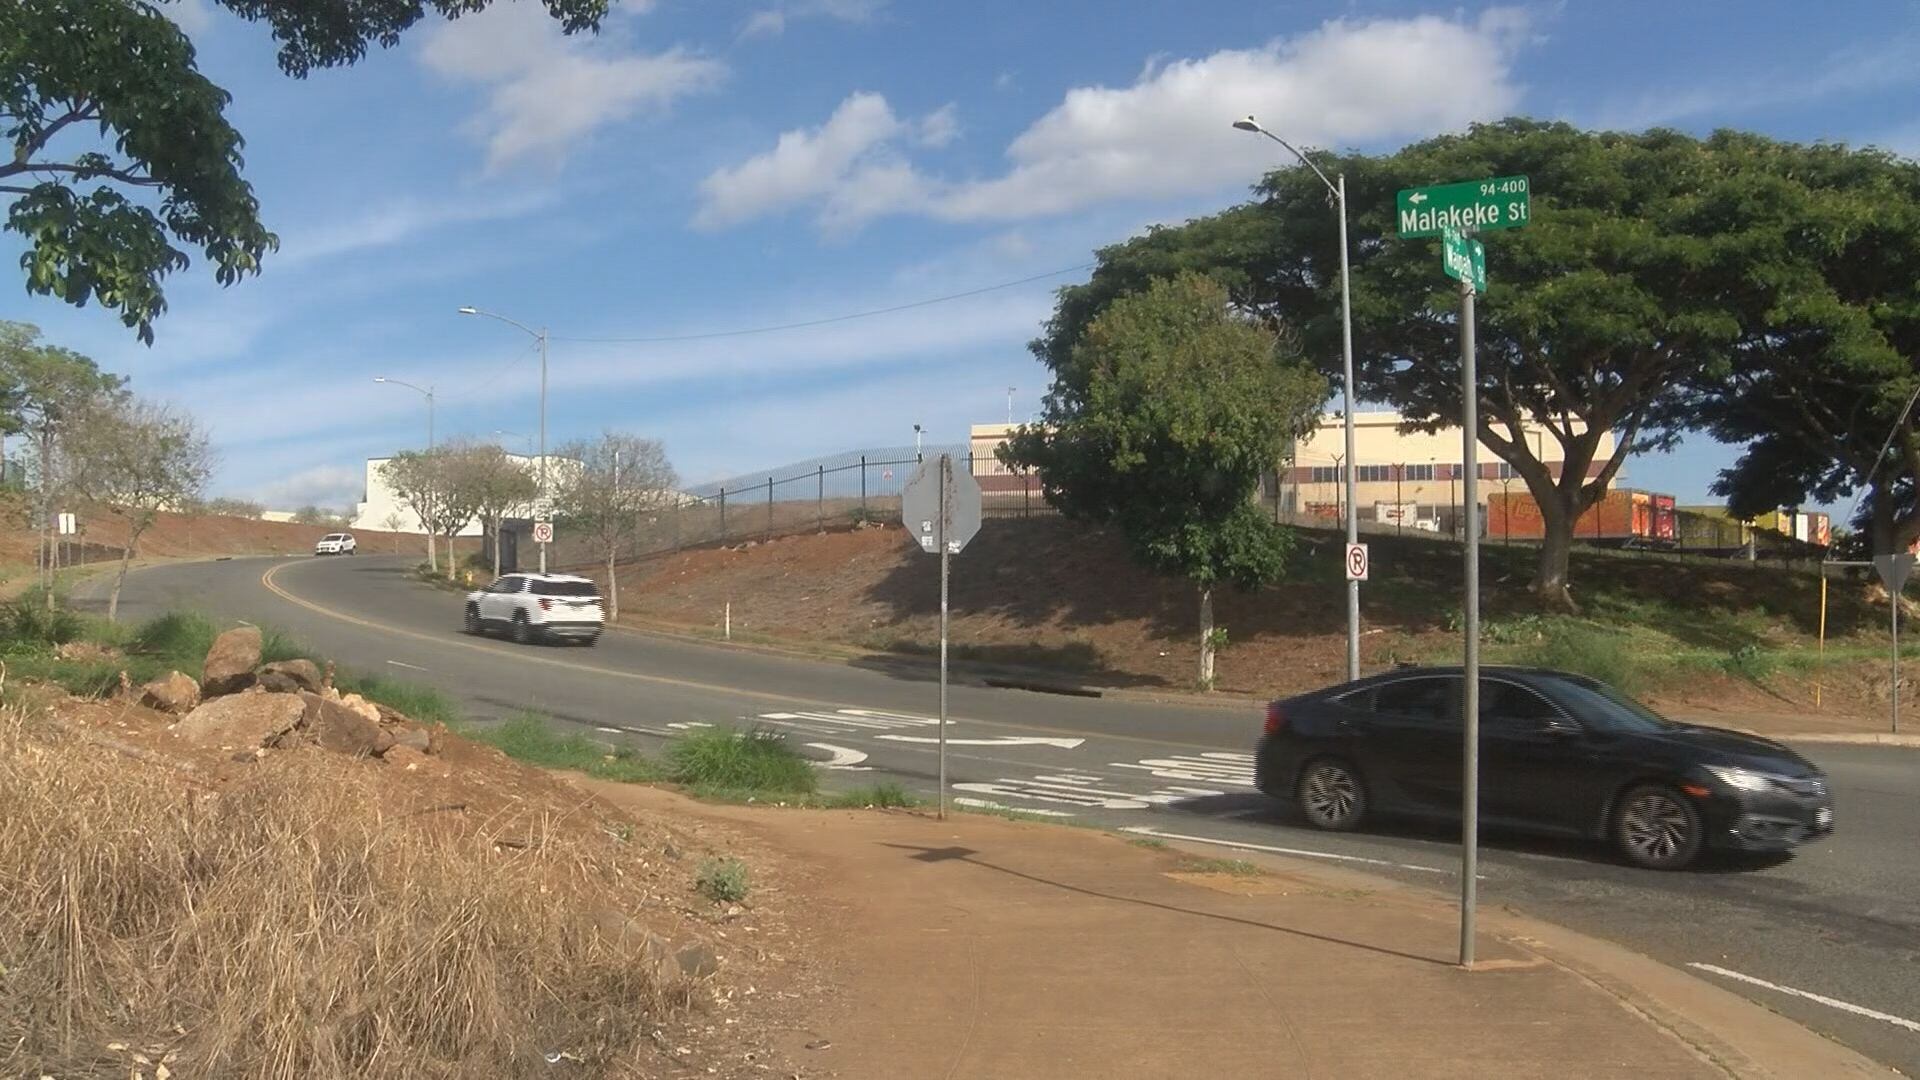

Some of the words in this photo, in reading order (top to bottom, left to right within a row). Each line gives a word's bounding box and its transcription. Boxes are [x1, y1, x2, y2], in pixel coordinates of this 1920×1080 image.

[1480, 179, 1526, 197] 94-400
[1401, 202, 1499, 233] Malakeke
[1508, 201, 1527, 221] St
